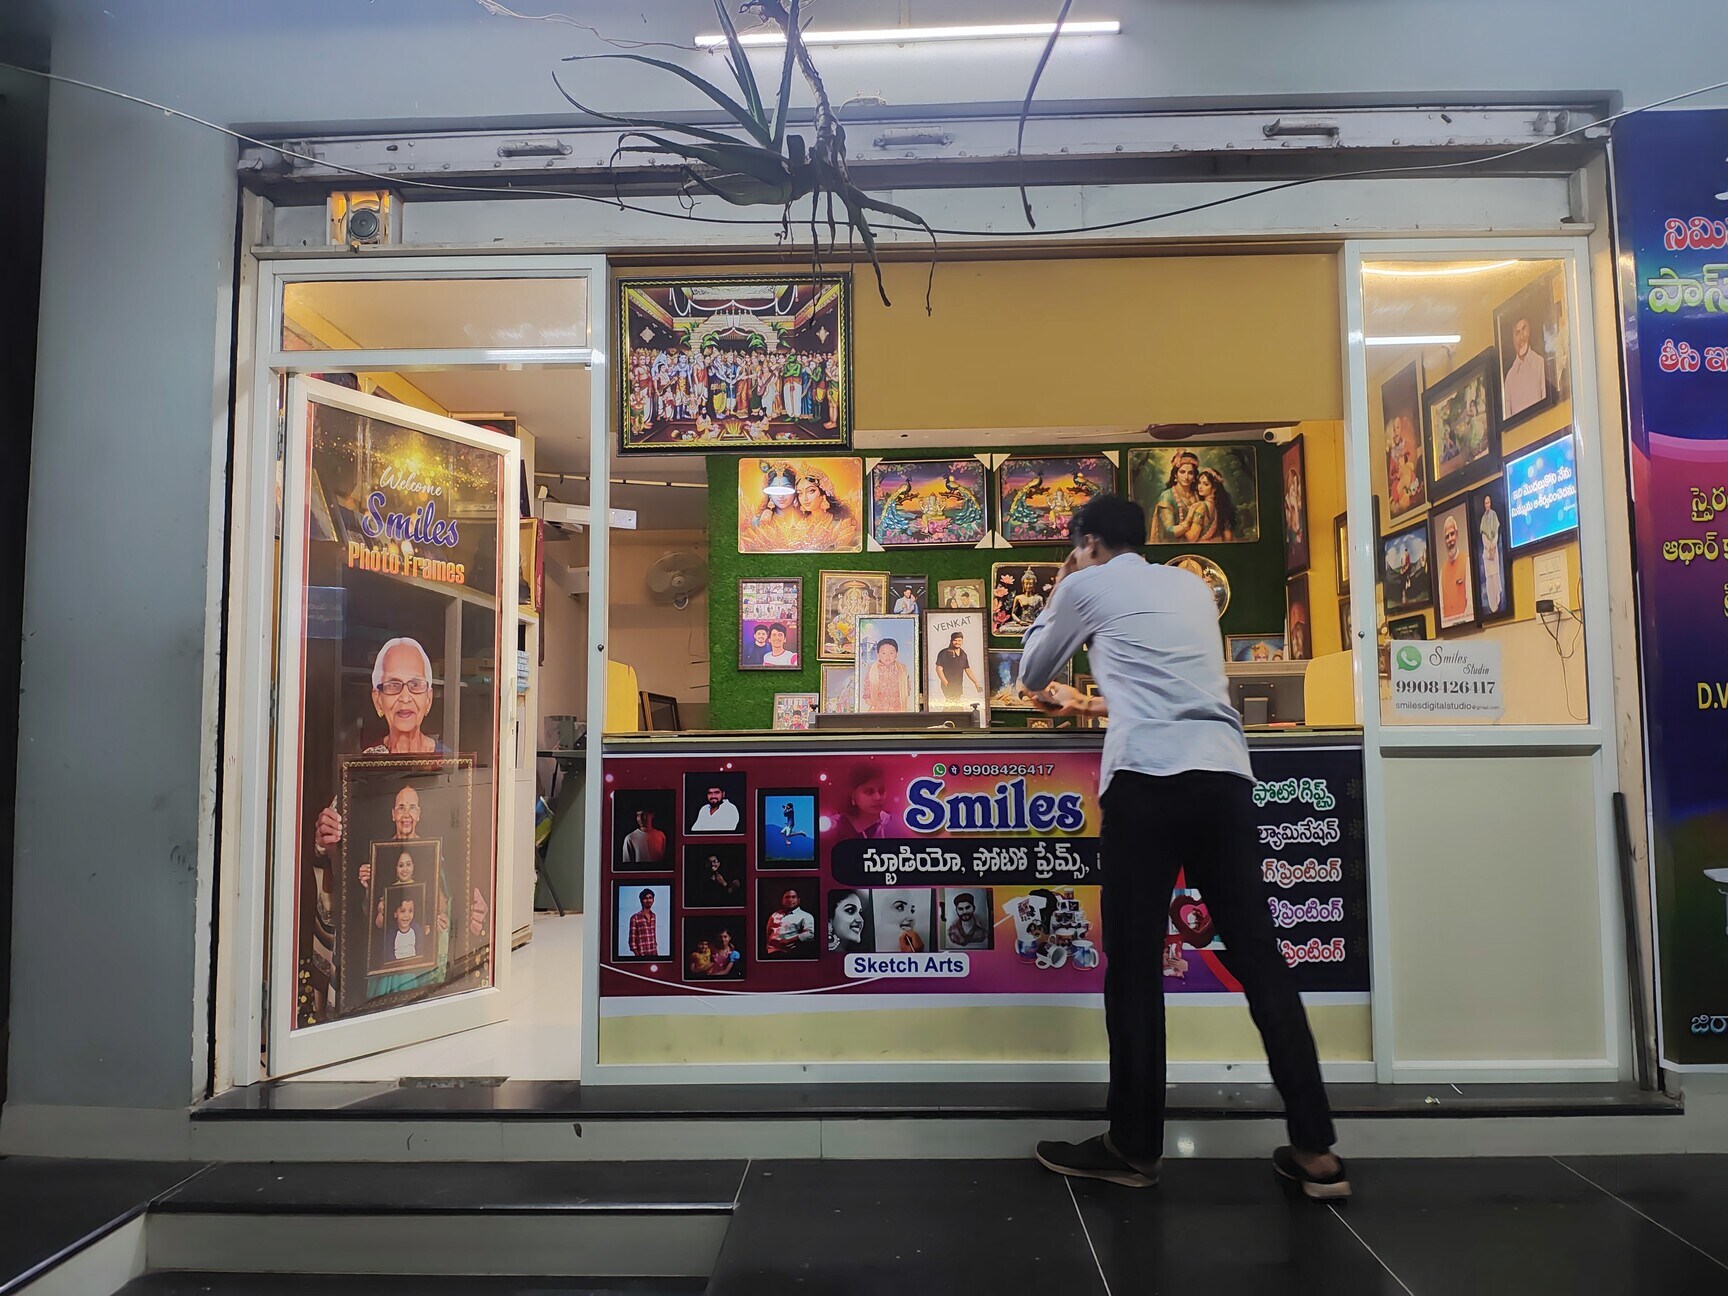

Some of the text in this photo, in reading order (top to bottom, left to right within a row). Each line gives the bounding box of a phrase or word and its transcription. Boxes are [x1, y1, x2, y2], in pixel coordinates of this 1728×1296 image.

[1664, 217, 1728, 250] నిమి
[1659, 339, 1700, 372] తీసి
[379, 466, 443, 497] Welcome
[361, 491, 459, 548] Smiles
[1690, 487, 1728, 522] స్పైర
[348, 540, 465, 585] Photo Frames
[1663, 532, 1719, 565] ఆధార్
[933, 616, 972, 632] VENKAT
[1429, 645, 1468, 667] Smiles
[1463, 663, 1490, 675] Studio
[963, 764, 1054, 776] 9908426417
[903, 776, 1085, 833] Smiles
[863, 846, 966, 885] స్టూడియో,
[972, 846, 1028, 878] ఫోటో
[1277, 858, 1342, 888] ప్రింటింగ్
[1279, 898, 1344, 928] ప్రింటింగ్
[853, 956, 964, 974] Sketch Arts
